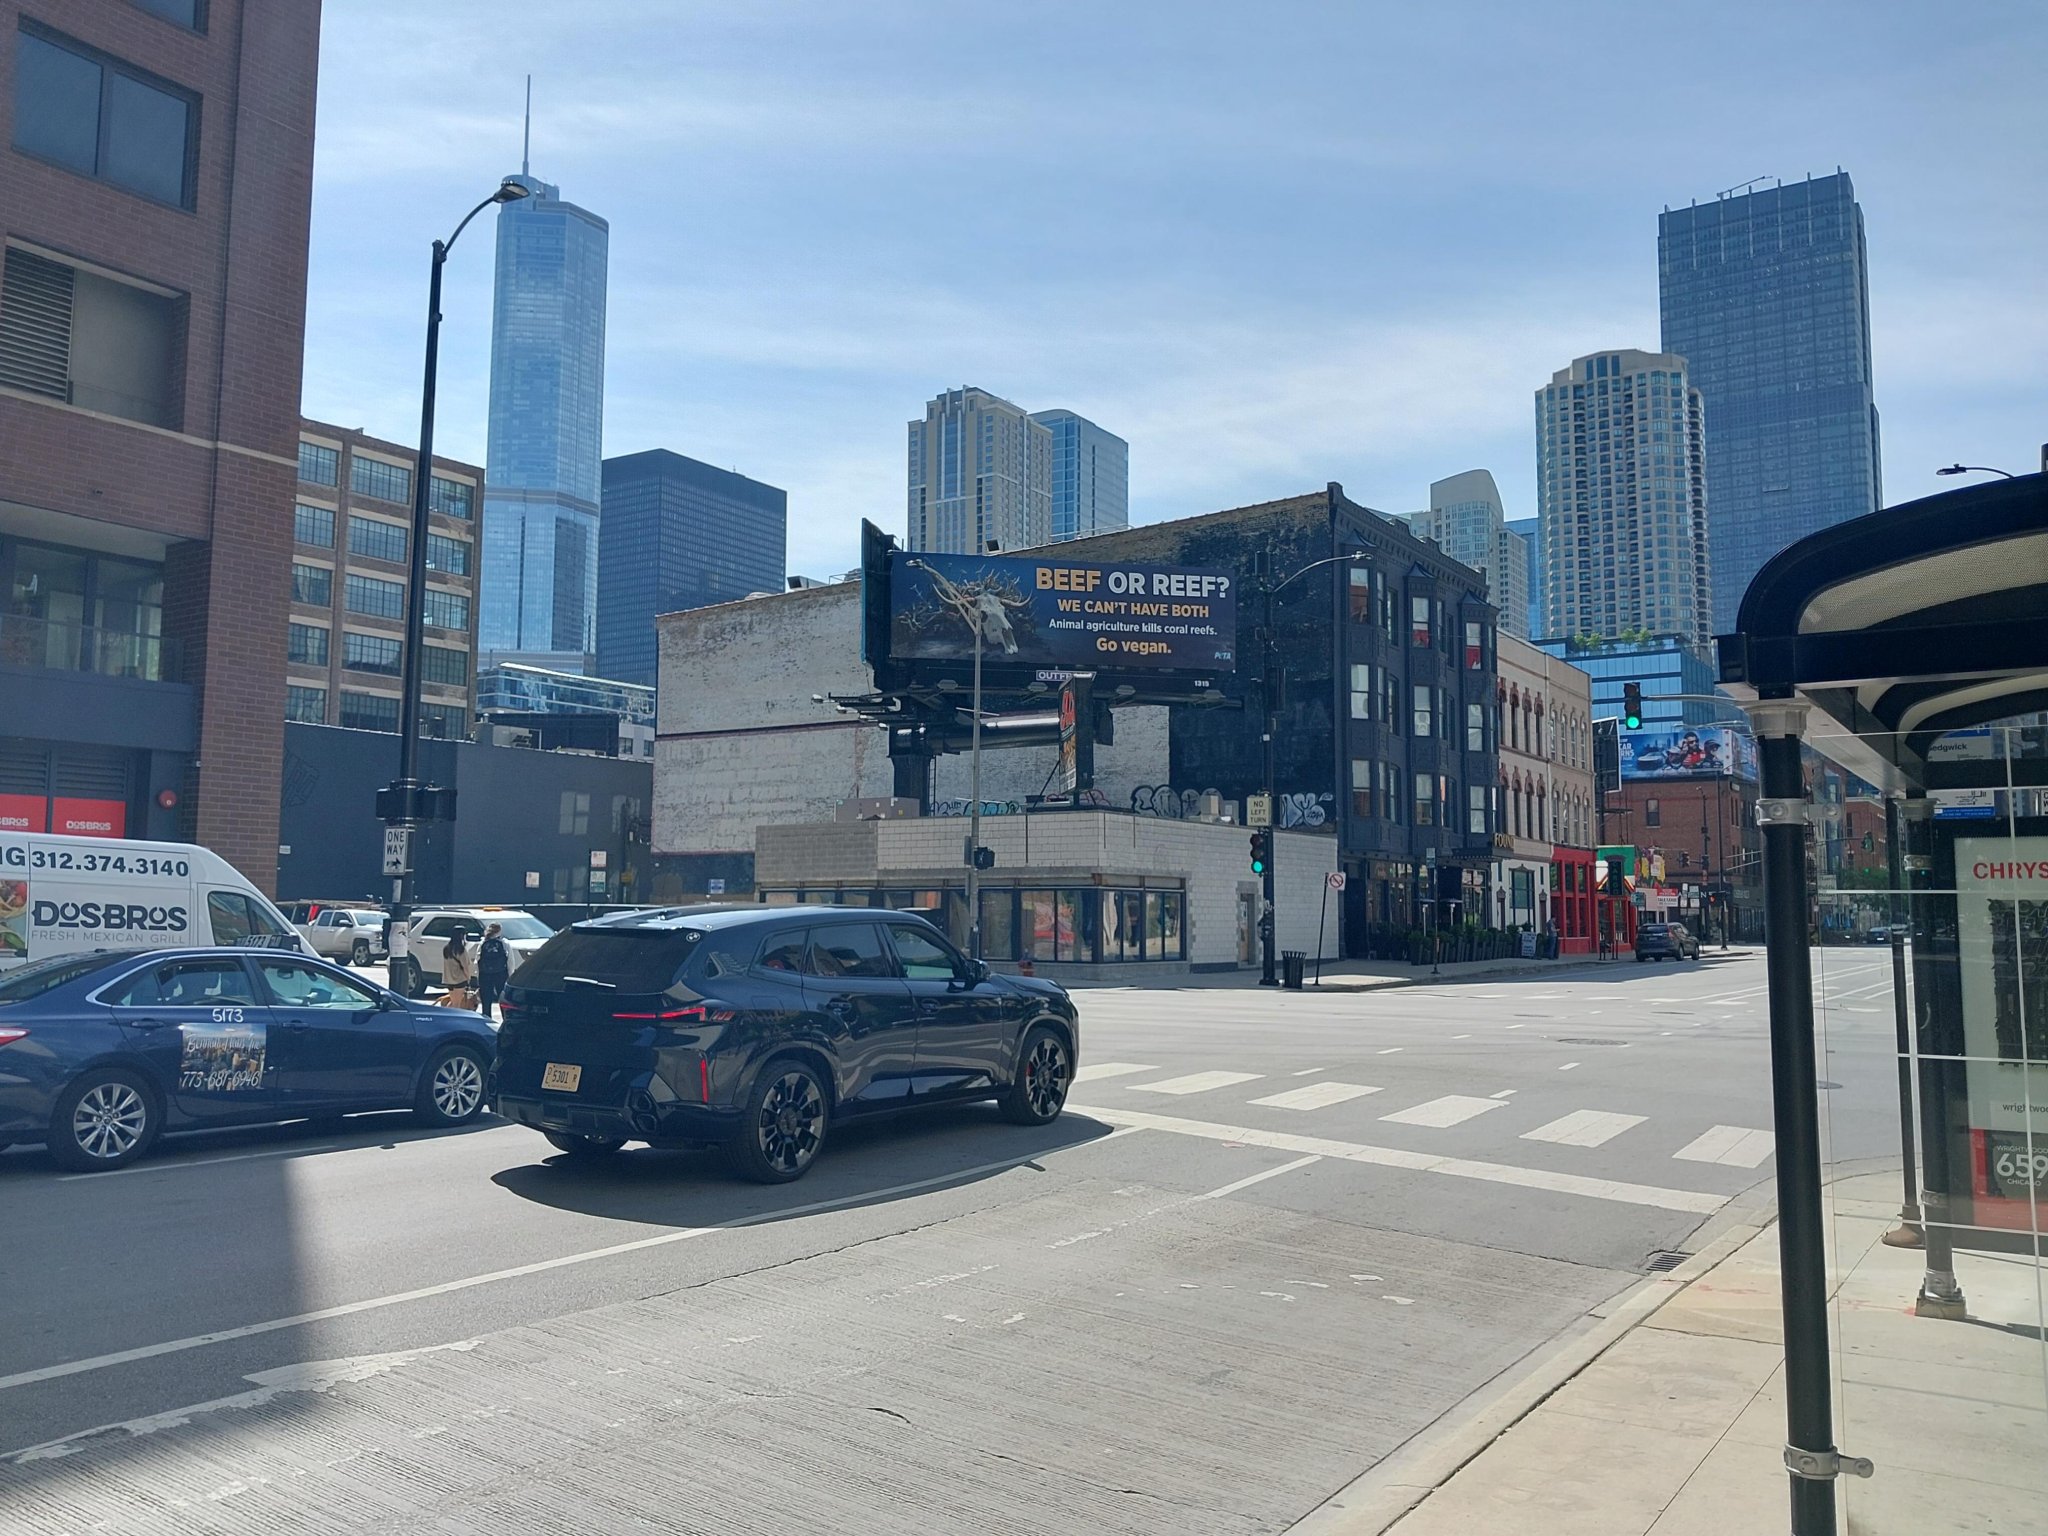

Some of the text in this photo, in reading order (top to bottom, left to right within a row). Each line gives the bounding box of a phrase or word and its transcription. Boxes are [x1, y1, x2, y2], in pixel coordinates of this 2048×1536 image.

[1036, 567, 1230, 598] BEEF OR REEF?
[1057, 599, 1209, 618] WE CAN'T HAVE BOTH
[1049, 618, 1218, 636] Animal agriculture kills coral reefs.
[1096, 637, 1172, 655] Go vegan.
[1253, 800, 1264, 808] NO
[1250, 808, 1266, 816] LEFT
[1250, 816, 1267, 824] TURN
[387, 831, 405, 843] ONE
[386, 844, 405, 856] WAY
[31, 850, 189, 877] 312.374.3140
[31, 930, 185, 944] FRESH MEXICAN GRILL
[212, 1008, 244, 1023] 5173
[2007, 1178, 2042, 1187] CHICAO
